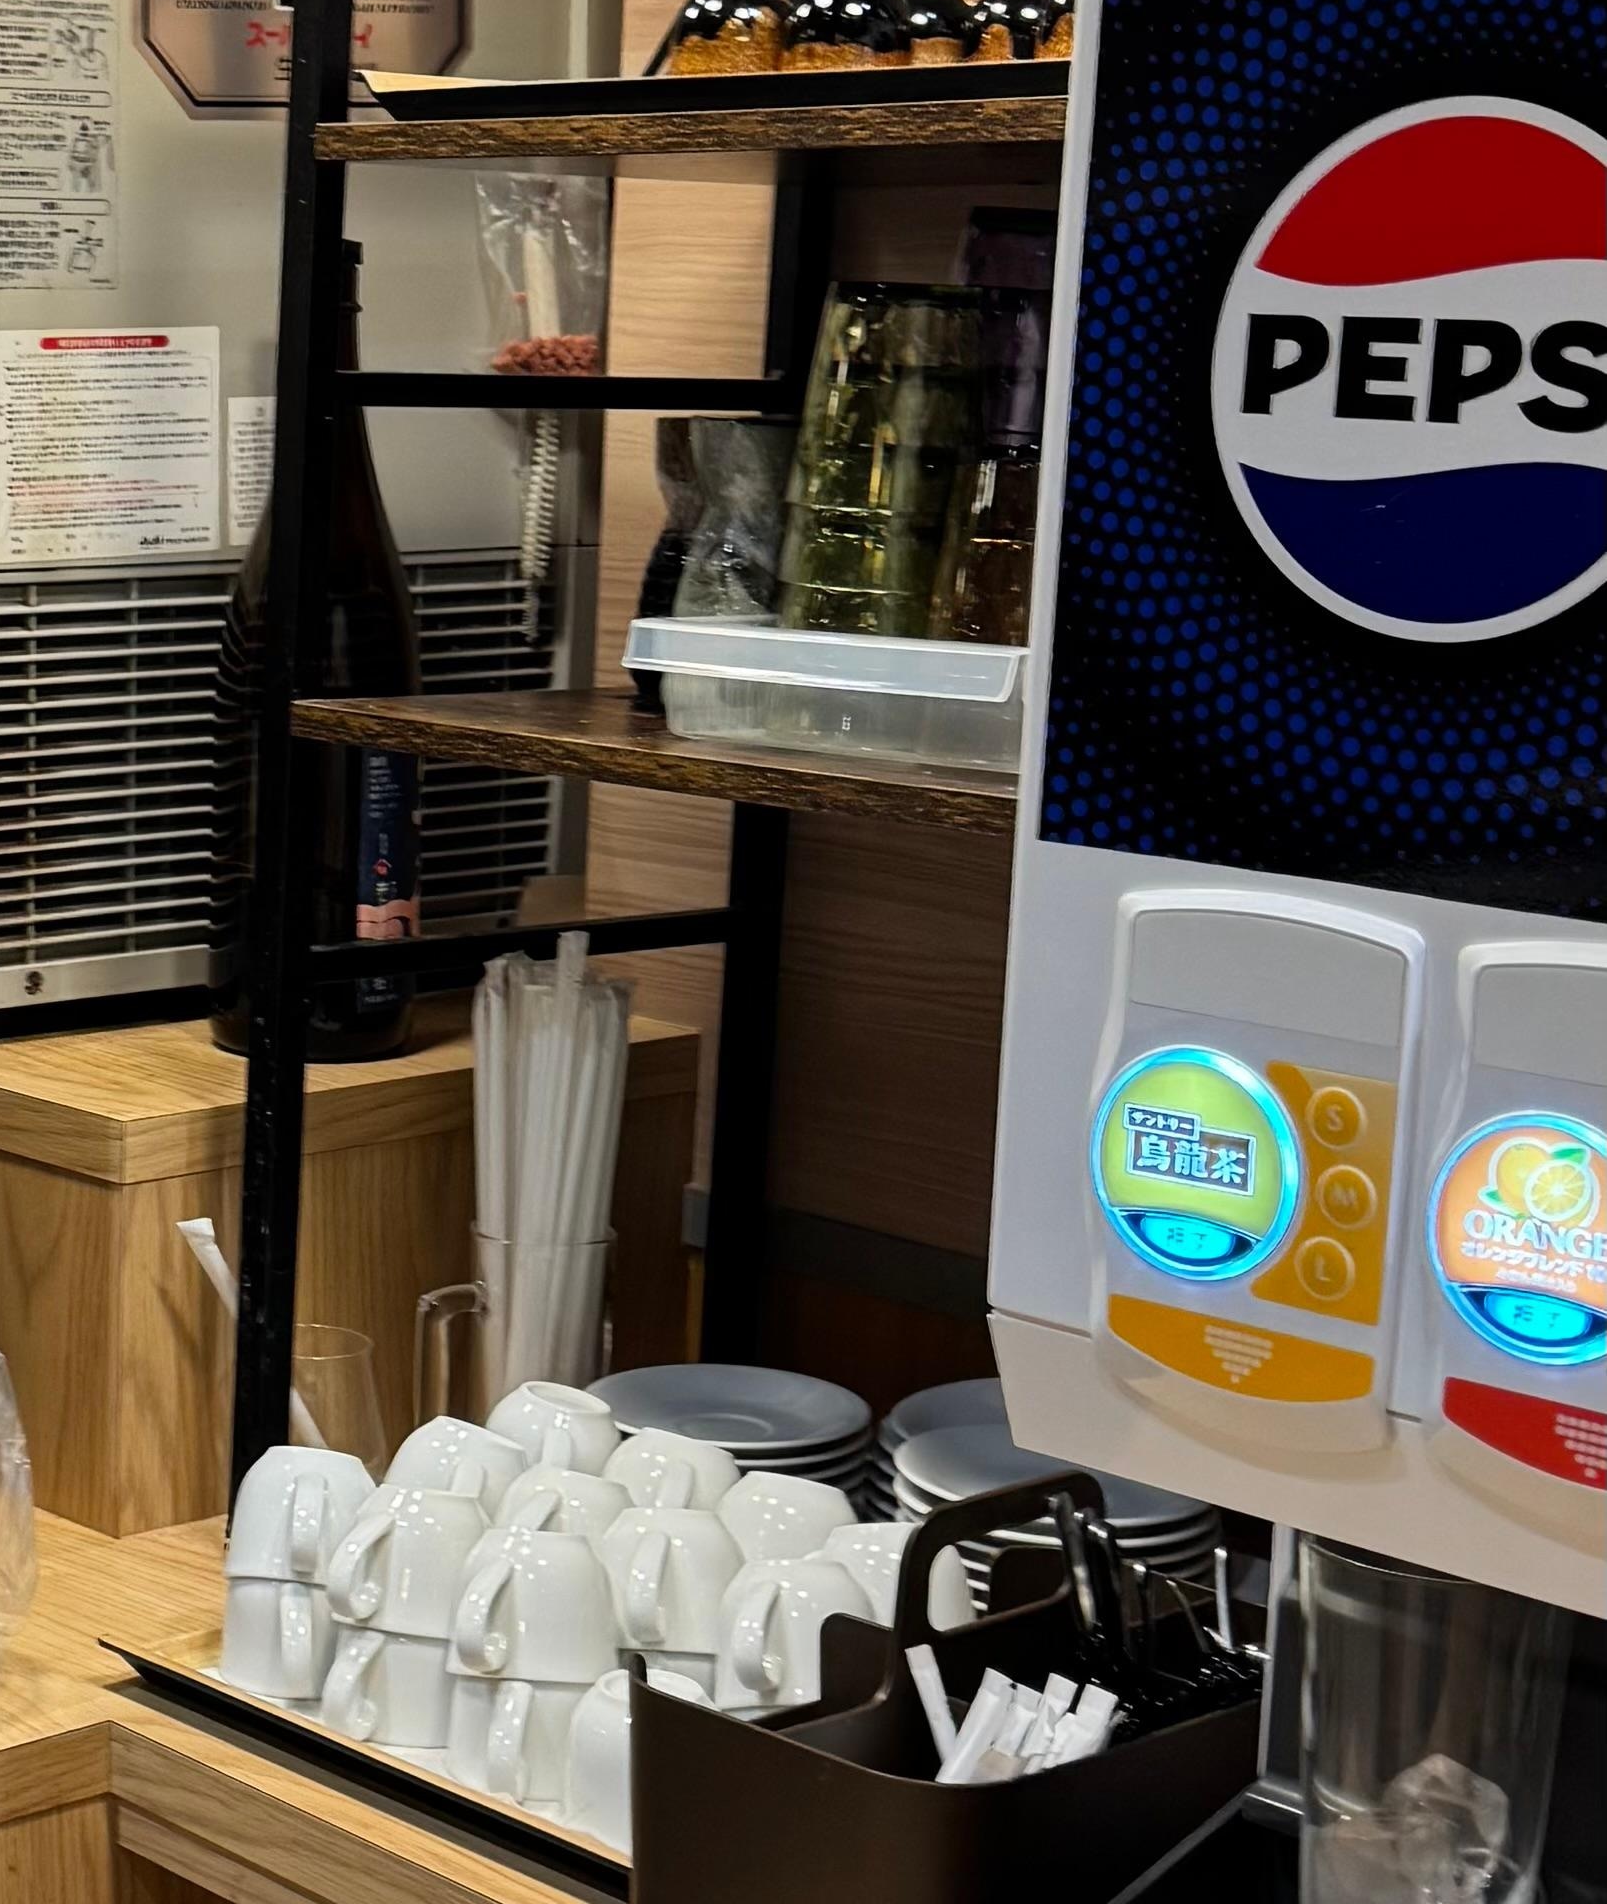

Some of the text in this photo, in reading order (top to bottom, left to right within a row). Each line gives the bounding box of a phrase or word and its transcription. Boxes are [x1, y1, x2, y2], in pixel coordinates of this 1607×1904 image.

[1131, 1110, 1194, 1131] サントリー
[1326, 1103, 1344, 1132] S
[1136, 1134, 1247, 1184] 烏龍茶
[1332, 1183, 1358, 1208] M
[1315, 1253, 1332, 1283] L
